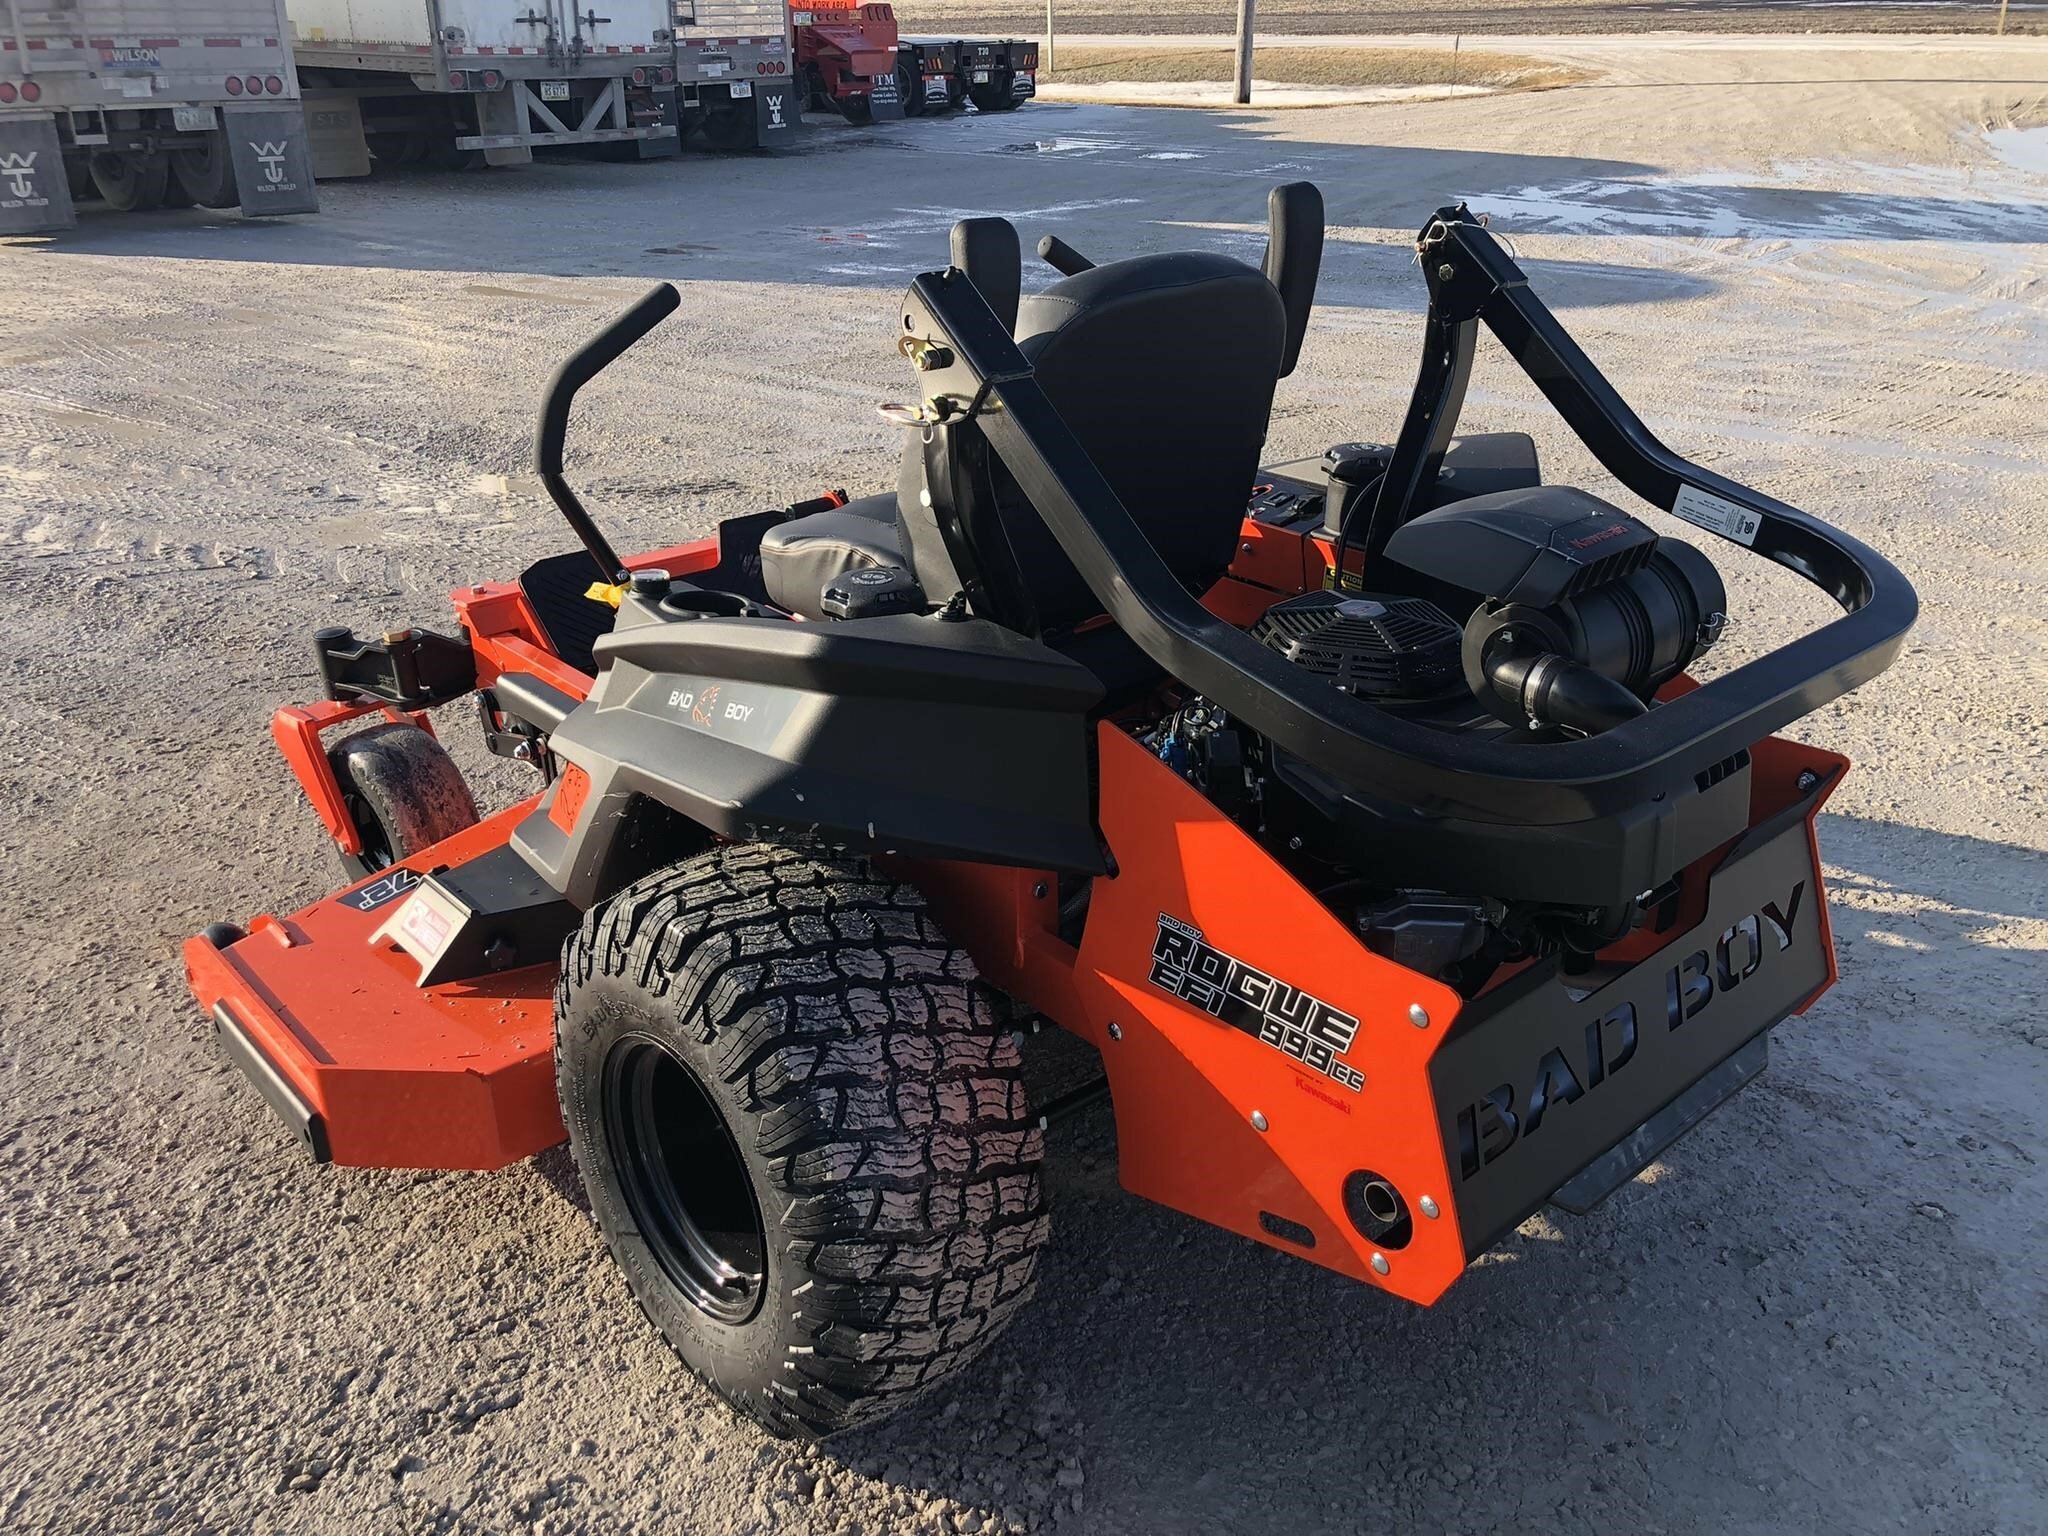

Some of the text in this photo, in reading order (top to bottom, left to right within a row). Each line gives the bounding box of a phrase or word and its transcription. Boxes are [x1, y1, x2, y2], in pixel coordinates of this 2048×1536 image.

[111, 48, 159, 62] WILSON
[668, 690, 754, 722] BAD BOY
[1148, 956, 1227, 1017] EFI
[1151, 921, 1362, 1056] ROGUE
[1457, 880, 1805, 1182] BAD BOY
[1295, 1076, 1352, 1115] Kawasaki
